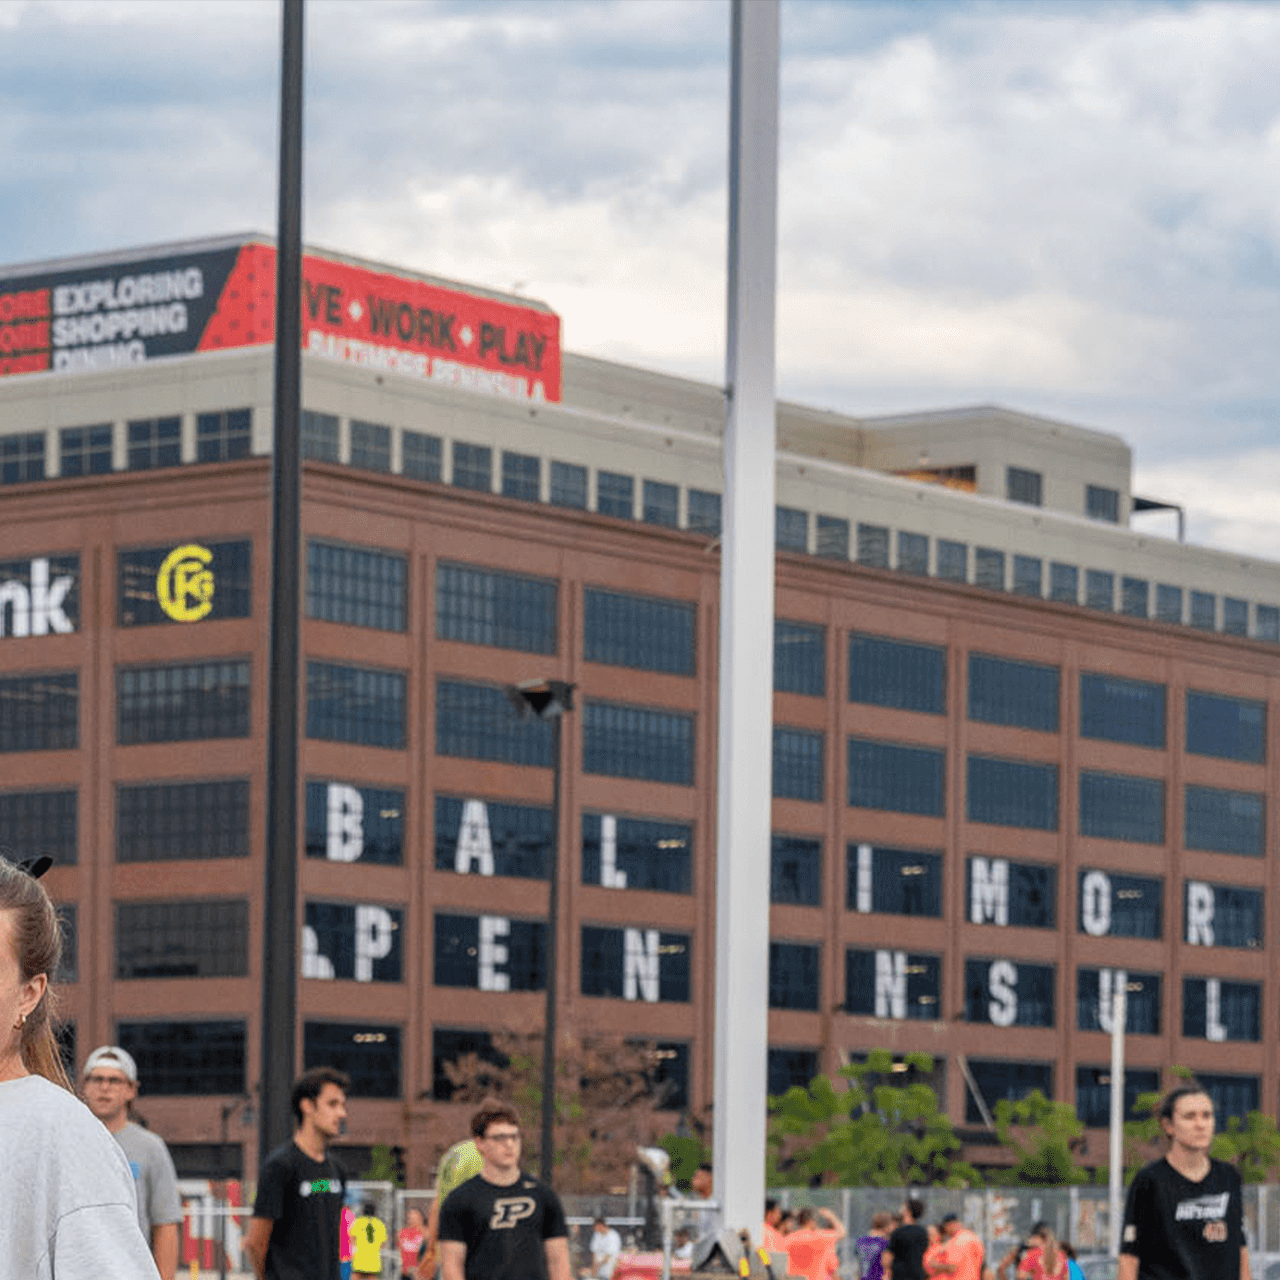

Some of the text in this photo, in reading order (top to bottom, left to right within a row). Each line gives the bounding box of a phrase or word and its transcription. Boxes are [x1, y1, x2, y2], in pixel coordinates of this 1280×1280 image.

[53, 267, 204, 316] EXPLORING
[53, 302, 188, 347] SHOPPING
[303, 277, 547, 371] VE WORK PLAY
